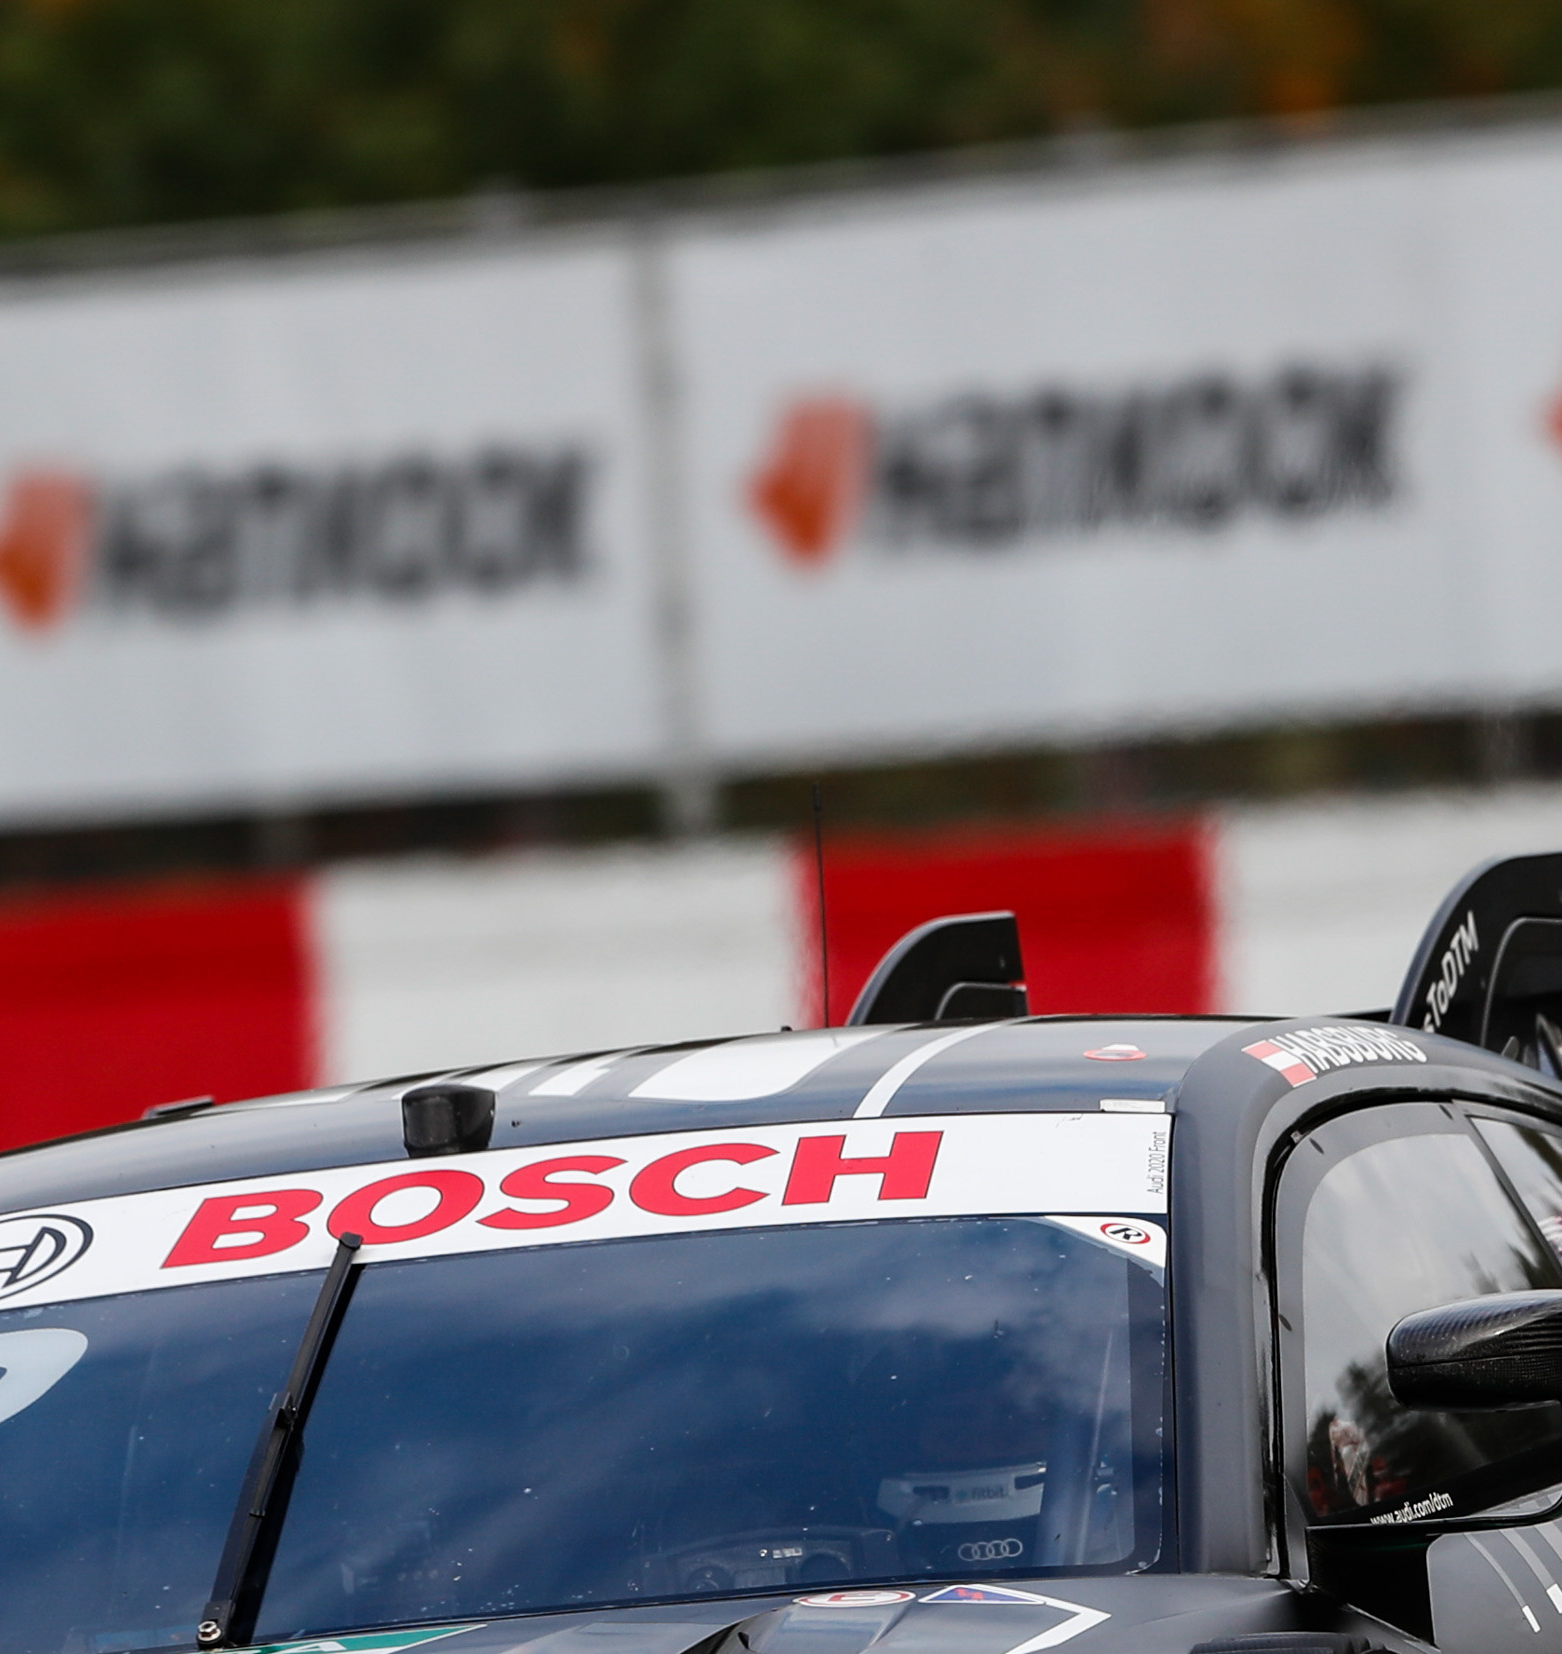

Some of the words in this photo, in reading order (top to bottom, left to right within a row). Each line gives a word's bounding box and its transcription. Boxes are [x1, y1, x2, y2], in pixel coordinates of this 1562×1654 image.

[1148, 1131, 1166, 1151] Front
[1148, 1154, 1165, 1173] 2020
[1147, 1174, 1165, 1194] Audi
[161, 1130, 944, 1269] BOSCH
[1370, 1491, 1453, 1525] www.audi.com/dtm
